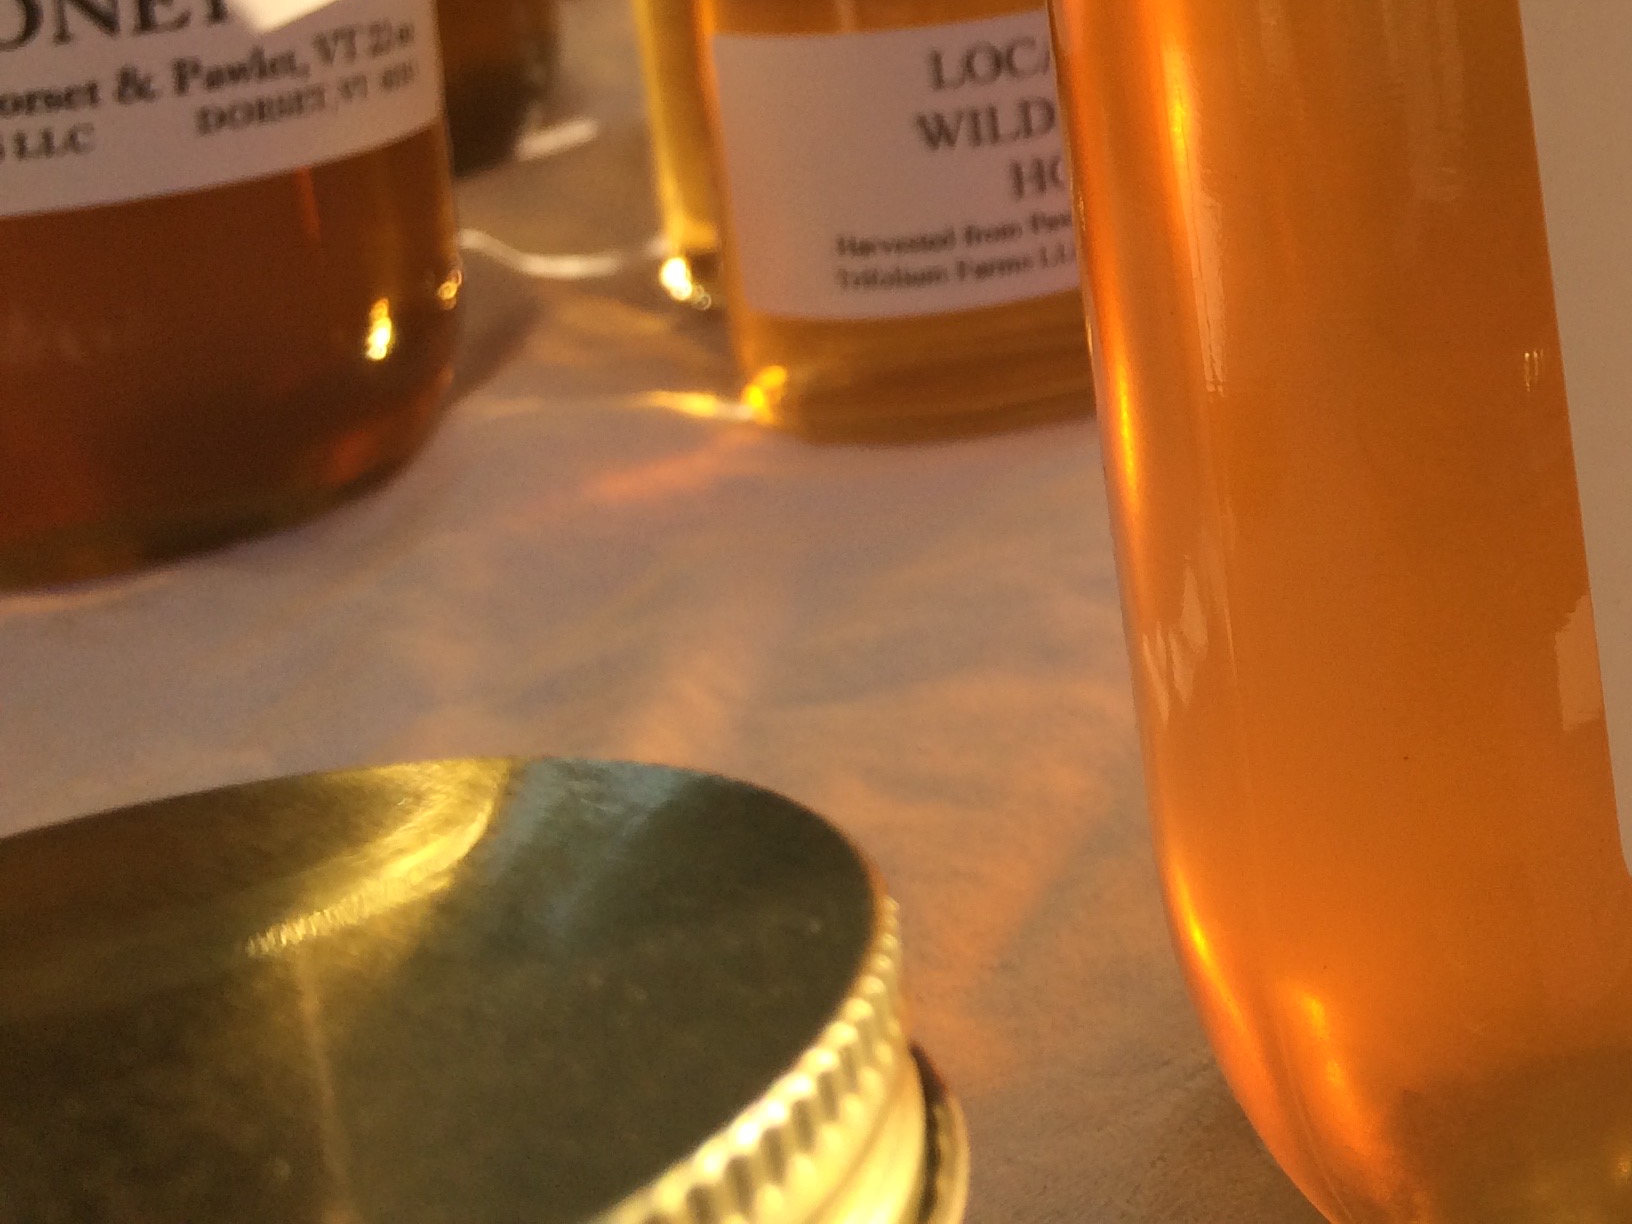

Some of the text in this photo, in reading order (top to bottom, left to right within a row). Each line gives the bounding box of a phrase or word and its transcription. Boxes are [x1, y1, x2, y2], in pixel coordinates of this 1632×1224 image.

[114, 63, 161, 107] &
[926, 34, 1050, 90] LOC
[913, 96, 1056, 150] WILD
